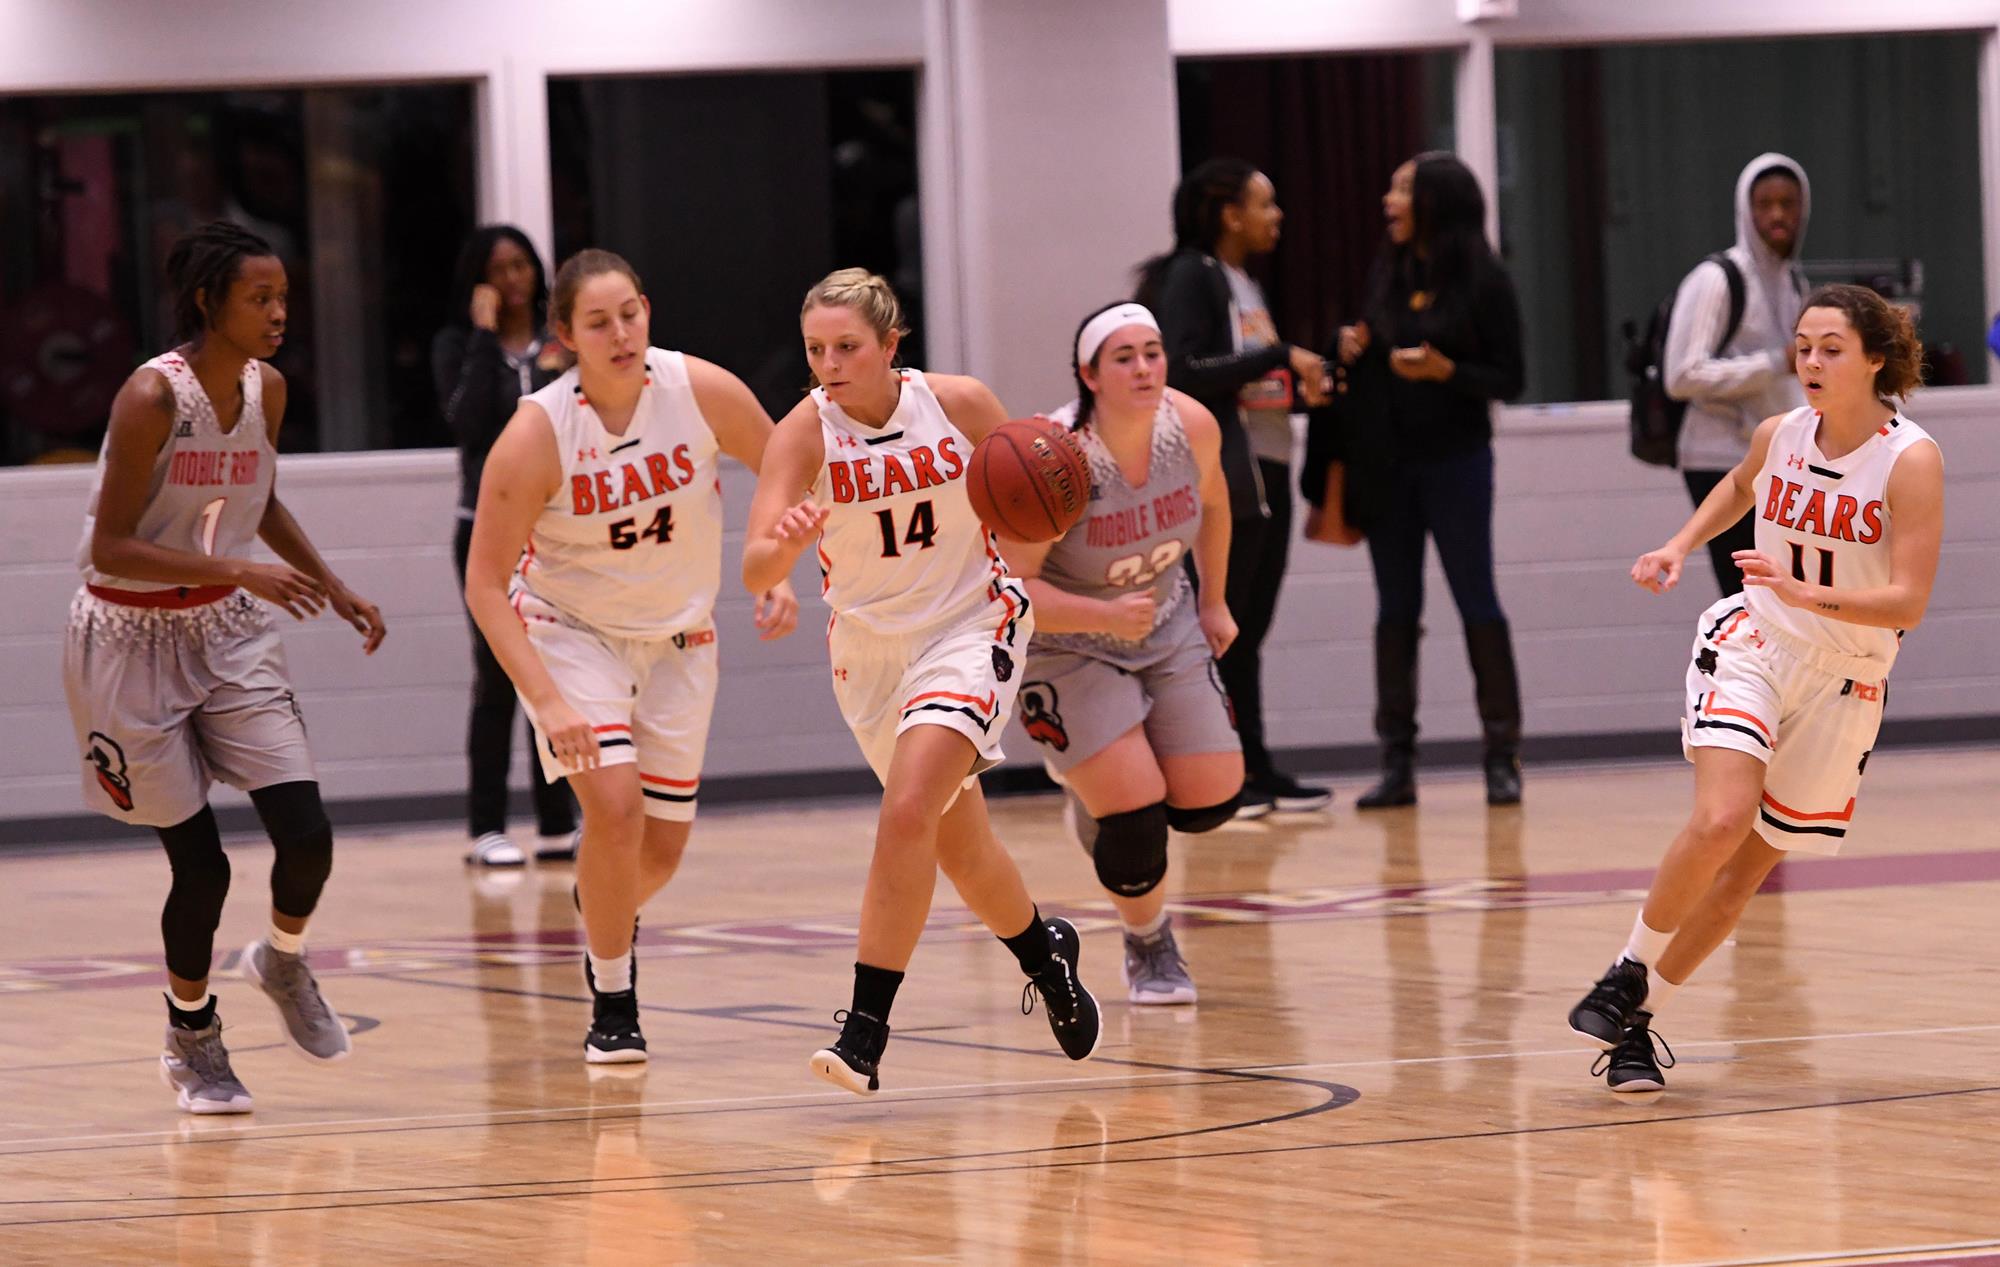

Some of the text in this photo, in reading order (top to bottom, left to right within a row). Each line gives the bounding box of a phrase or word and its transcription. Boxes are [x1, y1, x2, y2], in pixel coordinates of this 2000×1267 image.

[167, 450, 226, 486] MOBILE
[571, 443, 696, 515] BEARS
[827, 436, 964, 503] BEARS
[201, 496, 227, 557] 1
[608, 503, 676, 551] 54
[871, 499, 940, 558] 14
[1086, 484, 1197, 548] MOBILE RAMS
[1762, 475, 1884, 545] BEARS
[1785, 539, 1834, 587] 11
